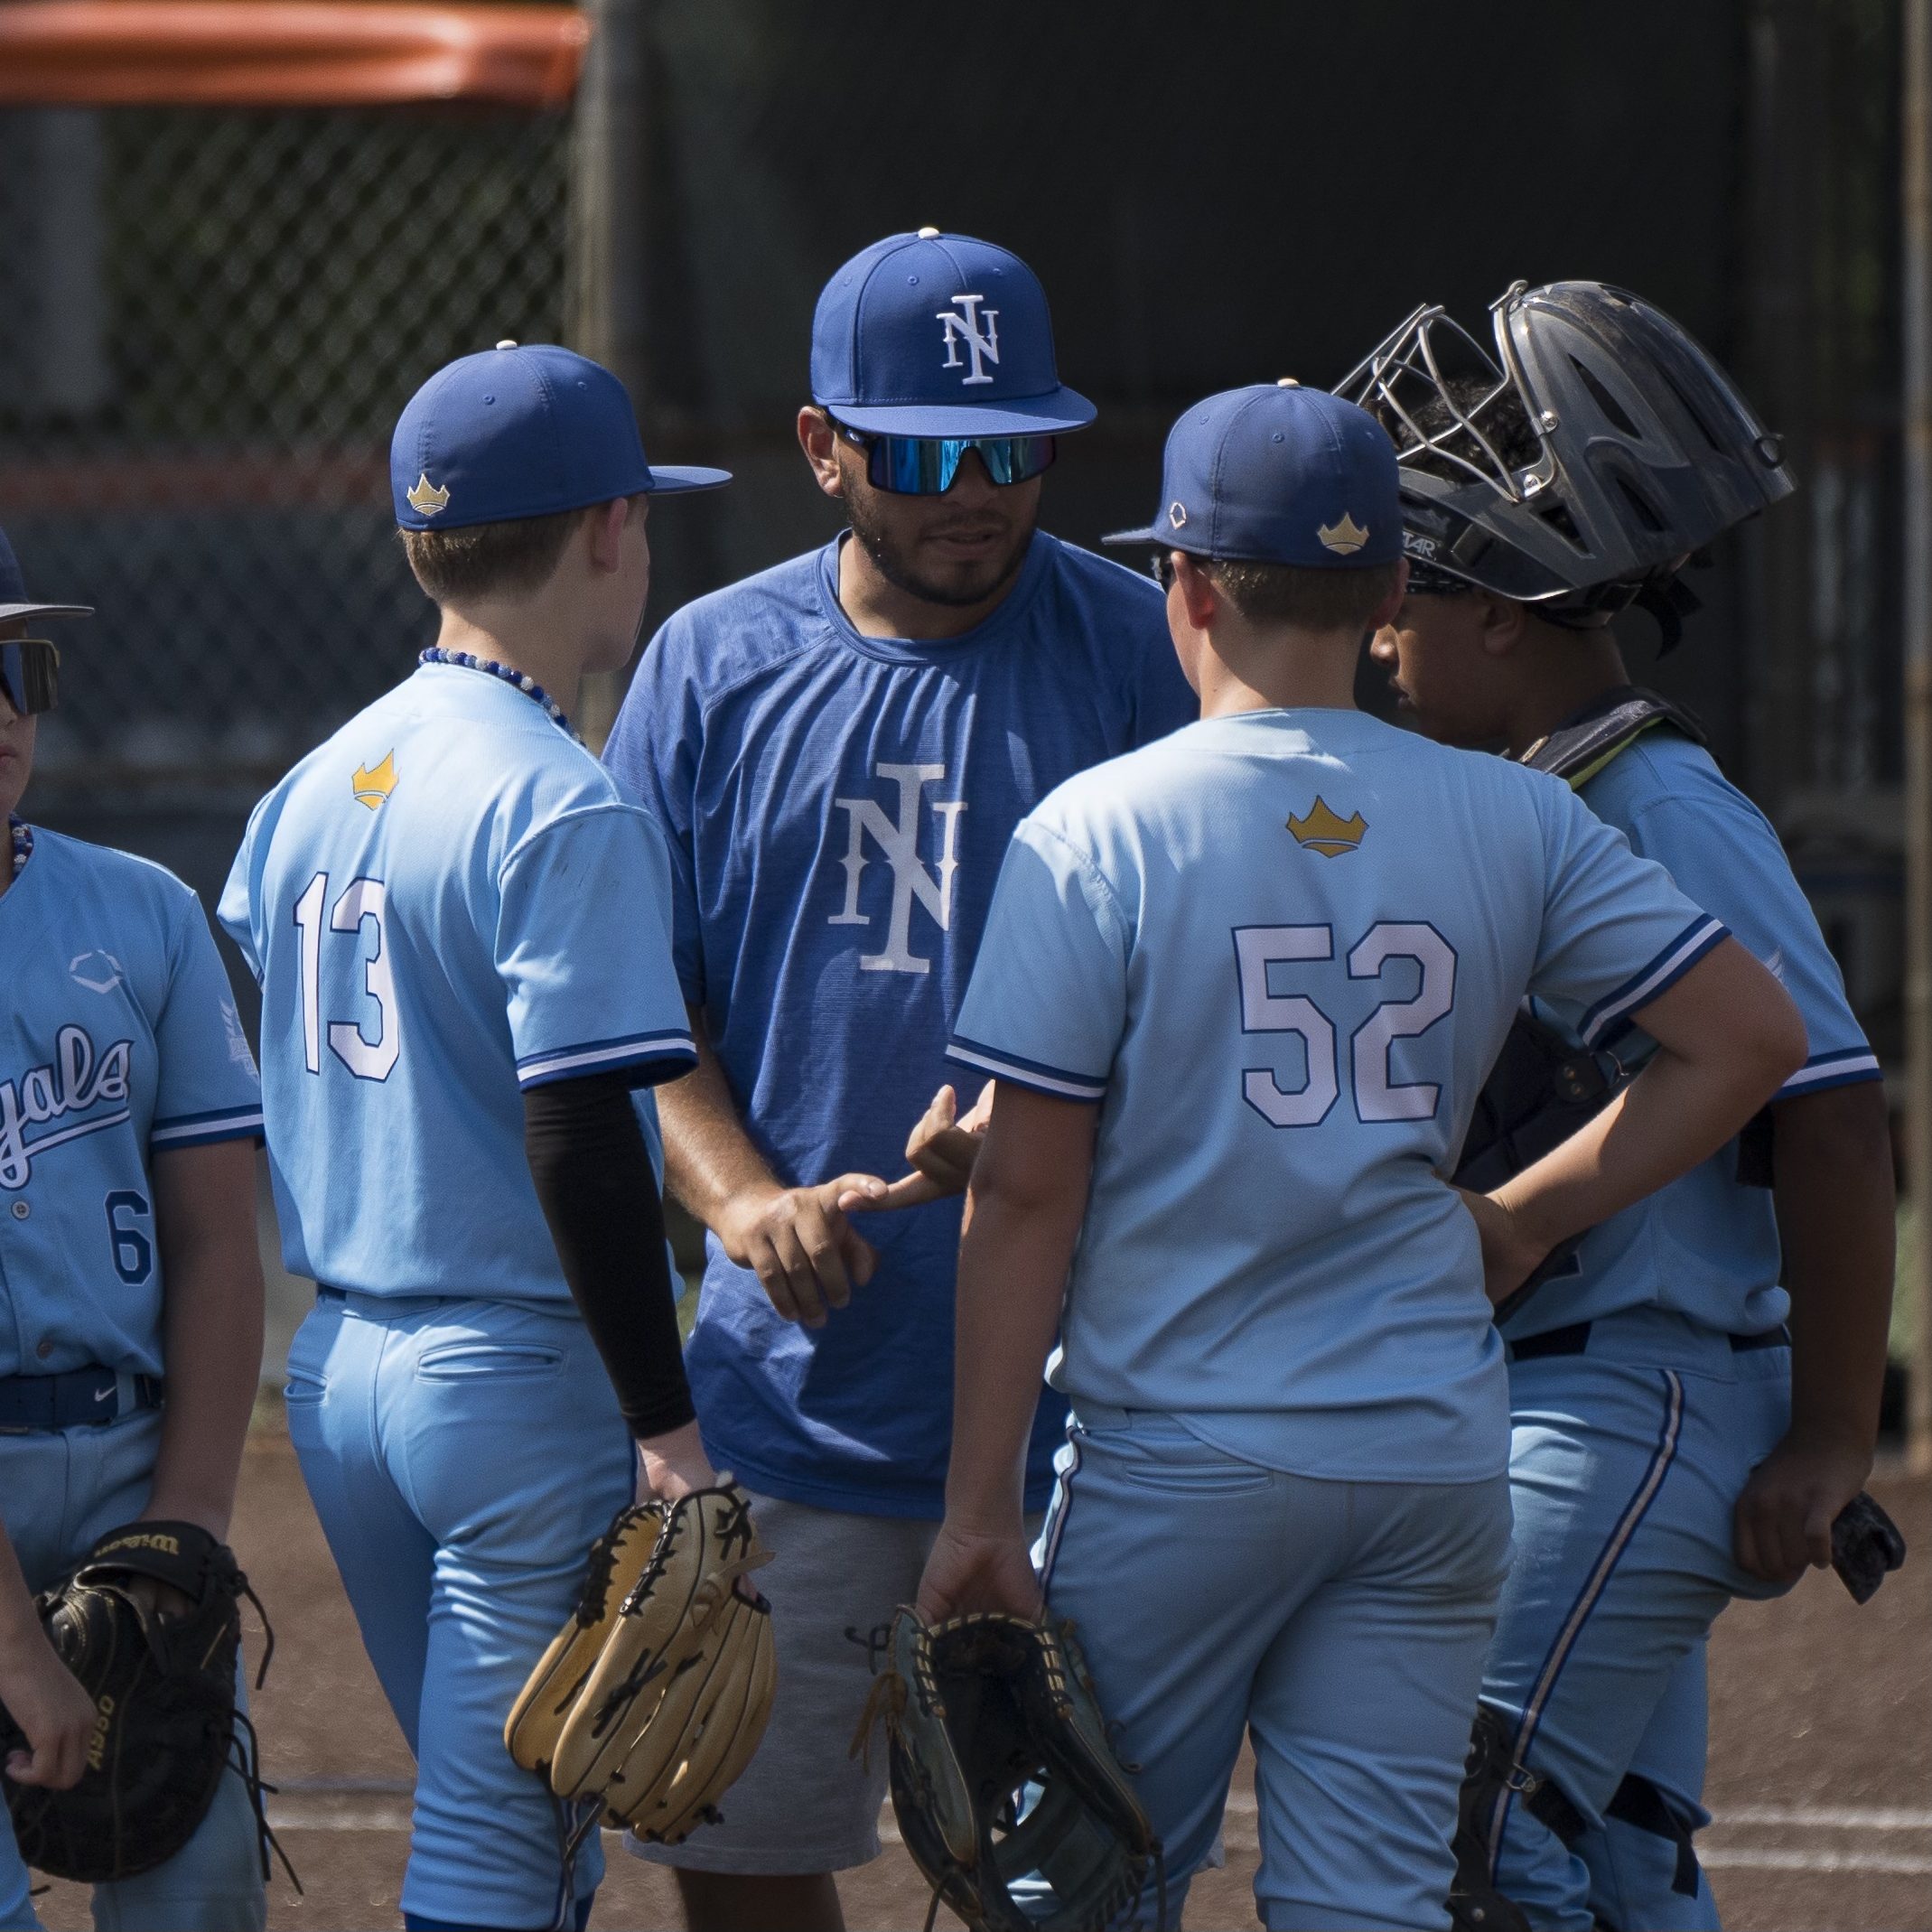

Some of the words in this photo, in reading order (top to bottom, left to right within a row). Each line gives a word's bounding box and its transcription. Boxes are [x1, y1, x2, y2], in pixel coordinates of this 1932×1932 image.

[1402, 531, 1435, 557] TAR
[293, 871, 400, 1084] 13
[1231, 919, 1459, 1129] 52
[104, 1189, 152, 1286] 6
